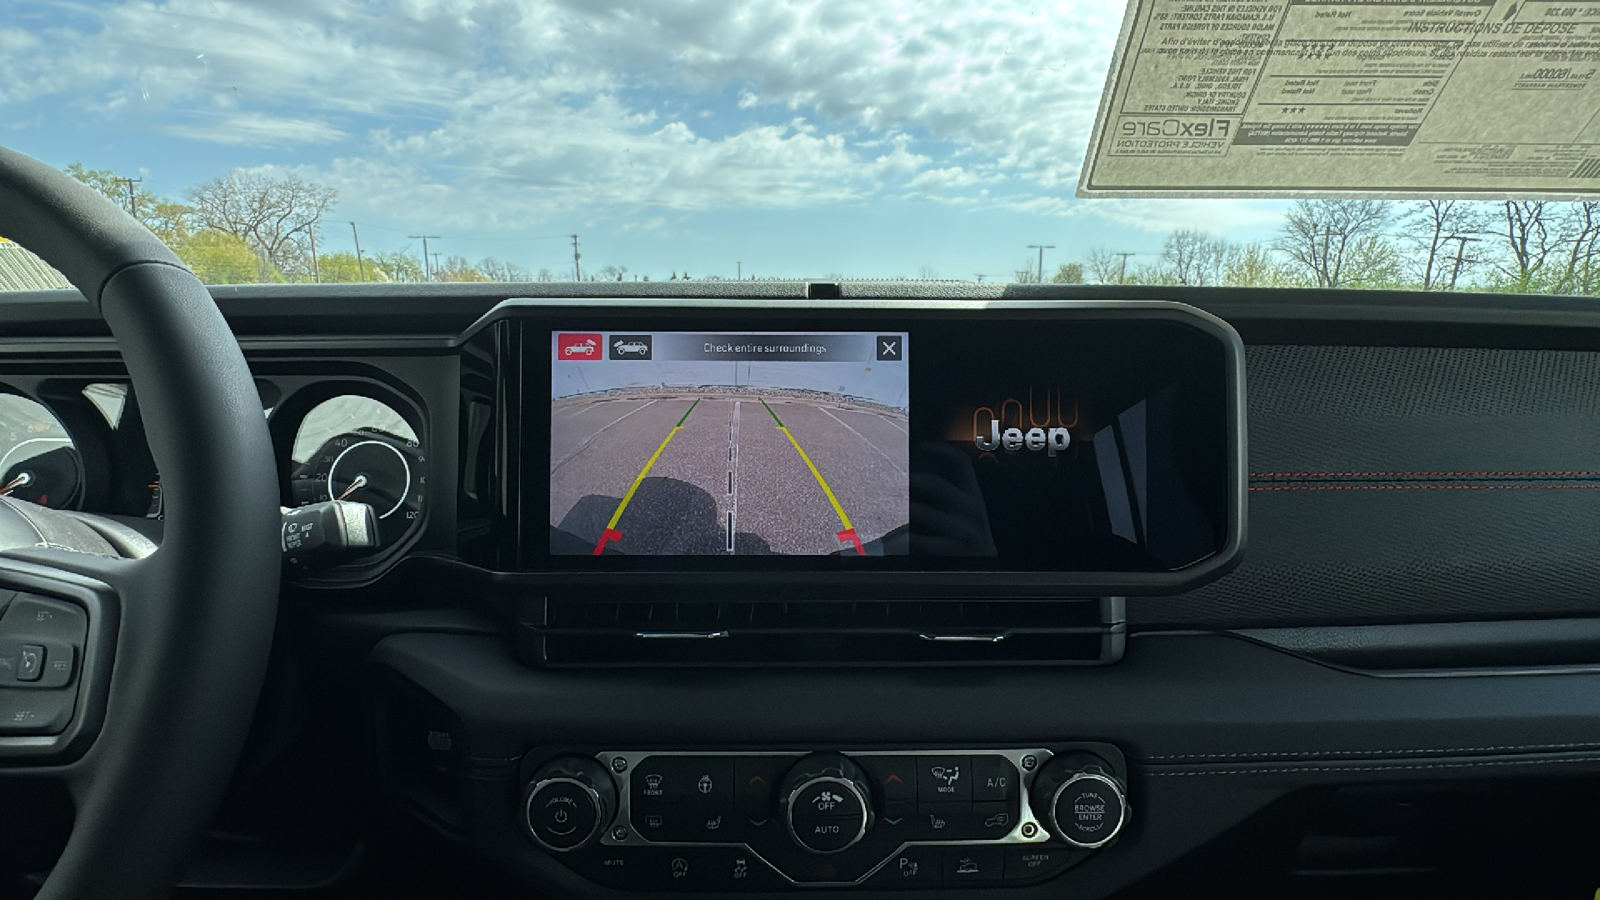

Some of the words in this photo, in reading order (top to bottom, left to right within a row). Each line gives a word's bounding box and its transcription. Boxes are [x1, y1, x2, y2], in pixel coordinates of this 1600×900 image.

[1407, 22, 1502, 33] INSTRUCTIONS
[1503, 22, 1523, 33] DE
[1161, 37, 1178, 45] Afin
[703, 343, 733, 353] Check
[735, 343, 763, 353] entire
[764, 343, 827, 355] surroundings
[976, 419, 1070, 457] Jeep
[334, 438, 348, 447] 40
[316, 474, 328, 482] 20
[986, 777, 1006, 788] A/C
[549, 796, 574, 804] VOLUME
[818, 802, 835, 810] OFF
[1074, 804, 1105, 812] BROWSE
[1078, 813, 1103, 821] ENTER
[814, 826, 840, 834] AUTO
[1077, 825, 1101, 833] SCROLL
[603, 858, 624, 866] MUTE
